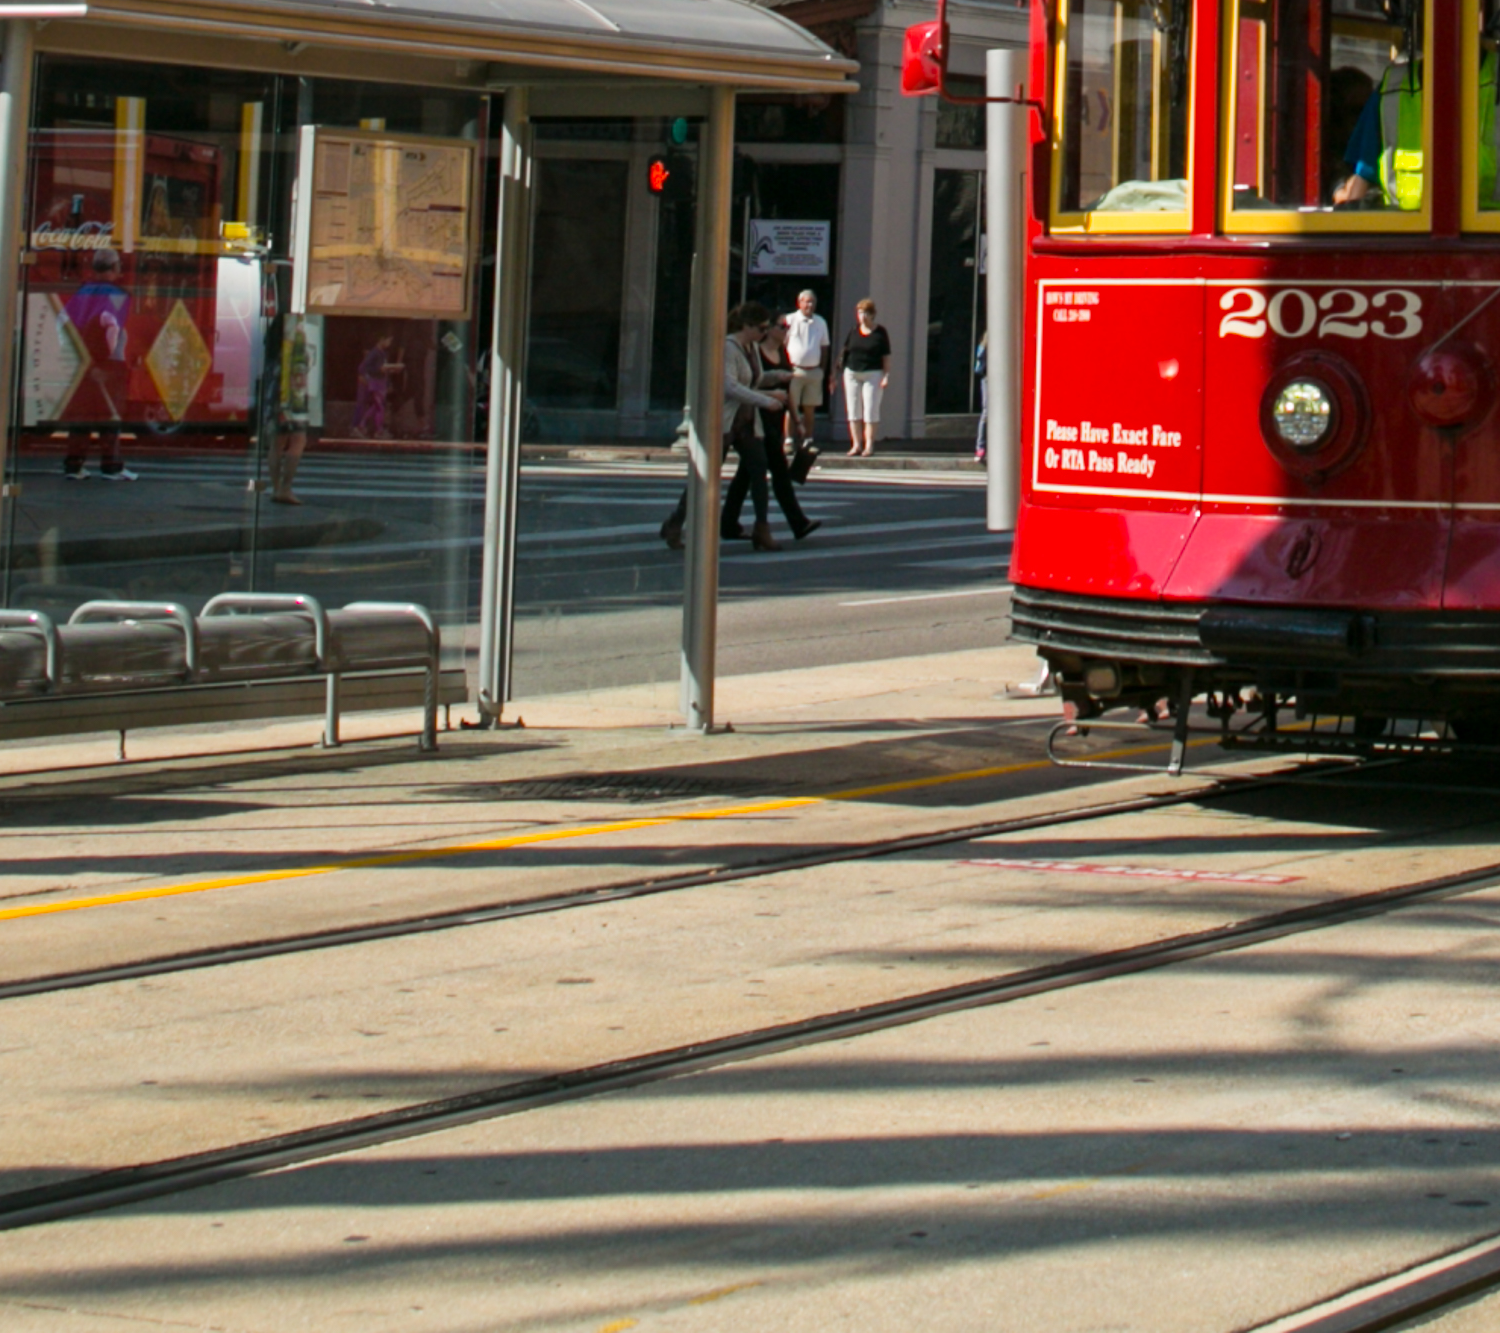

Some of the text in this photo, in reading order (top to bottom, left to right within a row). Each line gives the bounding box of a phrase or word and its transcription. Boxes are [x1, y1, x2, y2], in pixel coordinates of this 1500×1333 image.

[1219, 288, 1423, 340] 2023
[1046, 419, 1182, 448] Please Have Exact Fare
[1045, 447, 1157, 479] Or RTA Pass Ready
